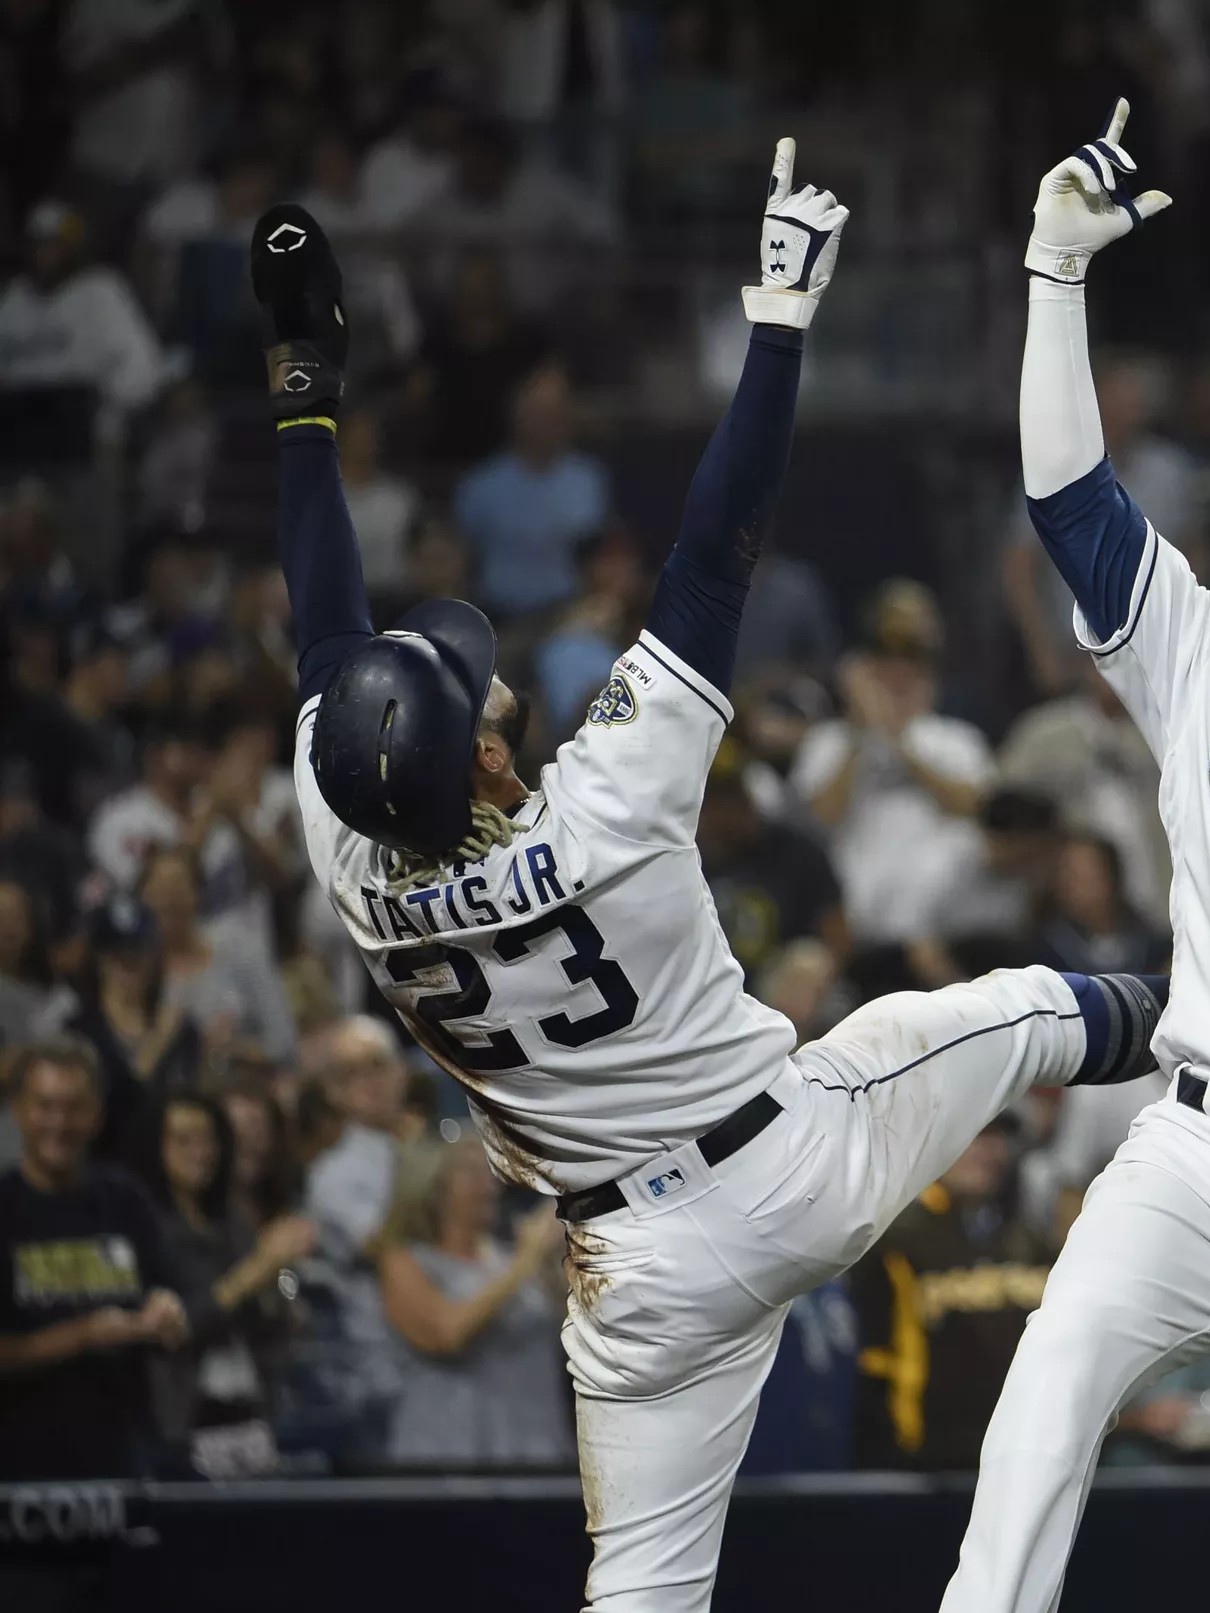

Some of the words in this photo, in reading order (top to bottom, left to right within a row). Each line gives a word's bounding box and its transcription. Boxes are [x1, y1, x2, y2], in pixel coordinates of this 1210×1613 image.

[629, 663, 652, 685] MLB
[360, 874, 503, 942] TATIS
[508, 842, 586, 916] JR.
[384, 902, 641, 1073] 23
